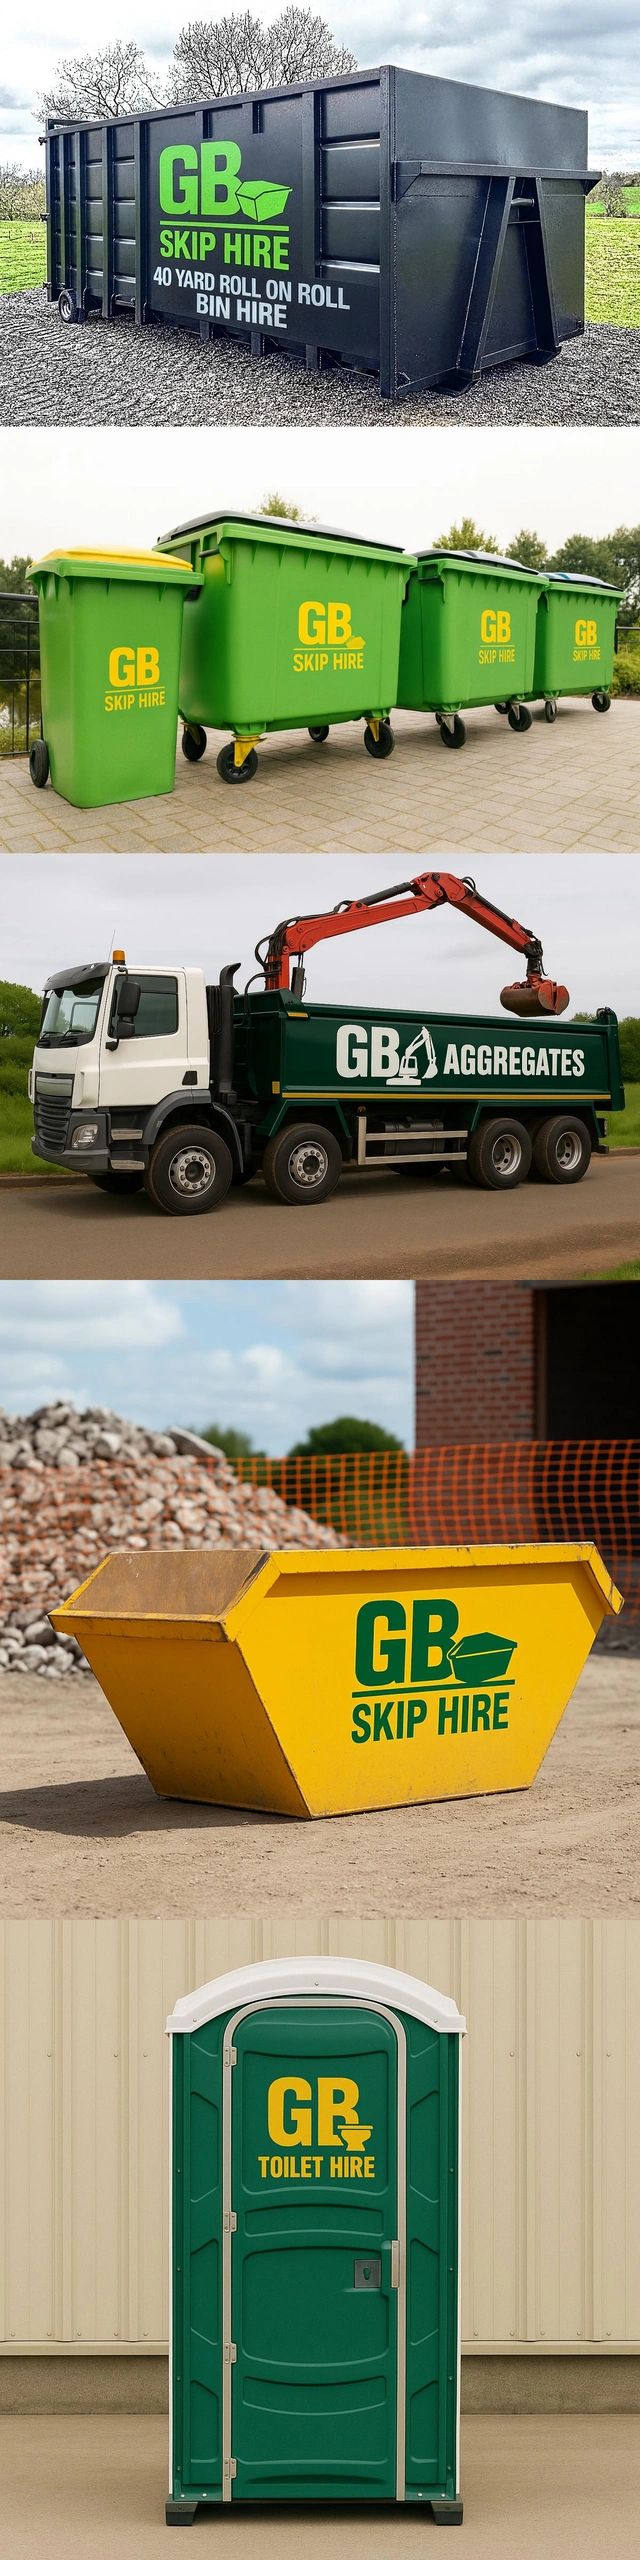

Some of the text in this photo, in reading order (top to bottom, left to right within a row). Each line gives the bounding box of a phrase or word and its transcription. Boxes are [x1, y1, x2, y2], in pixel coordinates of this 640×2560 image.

[159, 140, 243, 216] GB
[159, 230, 290, 271] SKIP HIRE
[153, 266, 350, 310] 40 YARD ROLL ON ROLL
[196, 293, 288, 329] BIN HIRE
[298, 602, 352, 645] GB
[480, 609, 511, 643] GB
[574, 619, 597, 646] GB
[108, 646, 160, 688] GB
[293, 651, 364, 672] SKIP HIRE
[478, 648, 515, 664] SKIP HIRE
[572, 648, 601, 661] SKIP HIRE
[105, 692, 165, 712] SKIP HIRE
[336, 1025, 585, 1078] GB AGGREGATES
[354, 1599, 459, 1686] GB
[352, 1692, 509, 1744] SKIP HIRE
[267, 2076, 360, 2147] GB
[258, 2156, 375, 2178] TOILET HIRE
